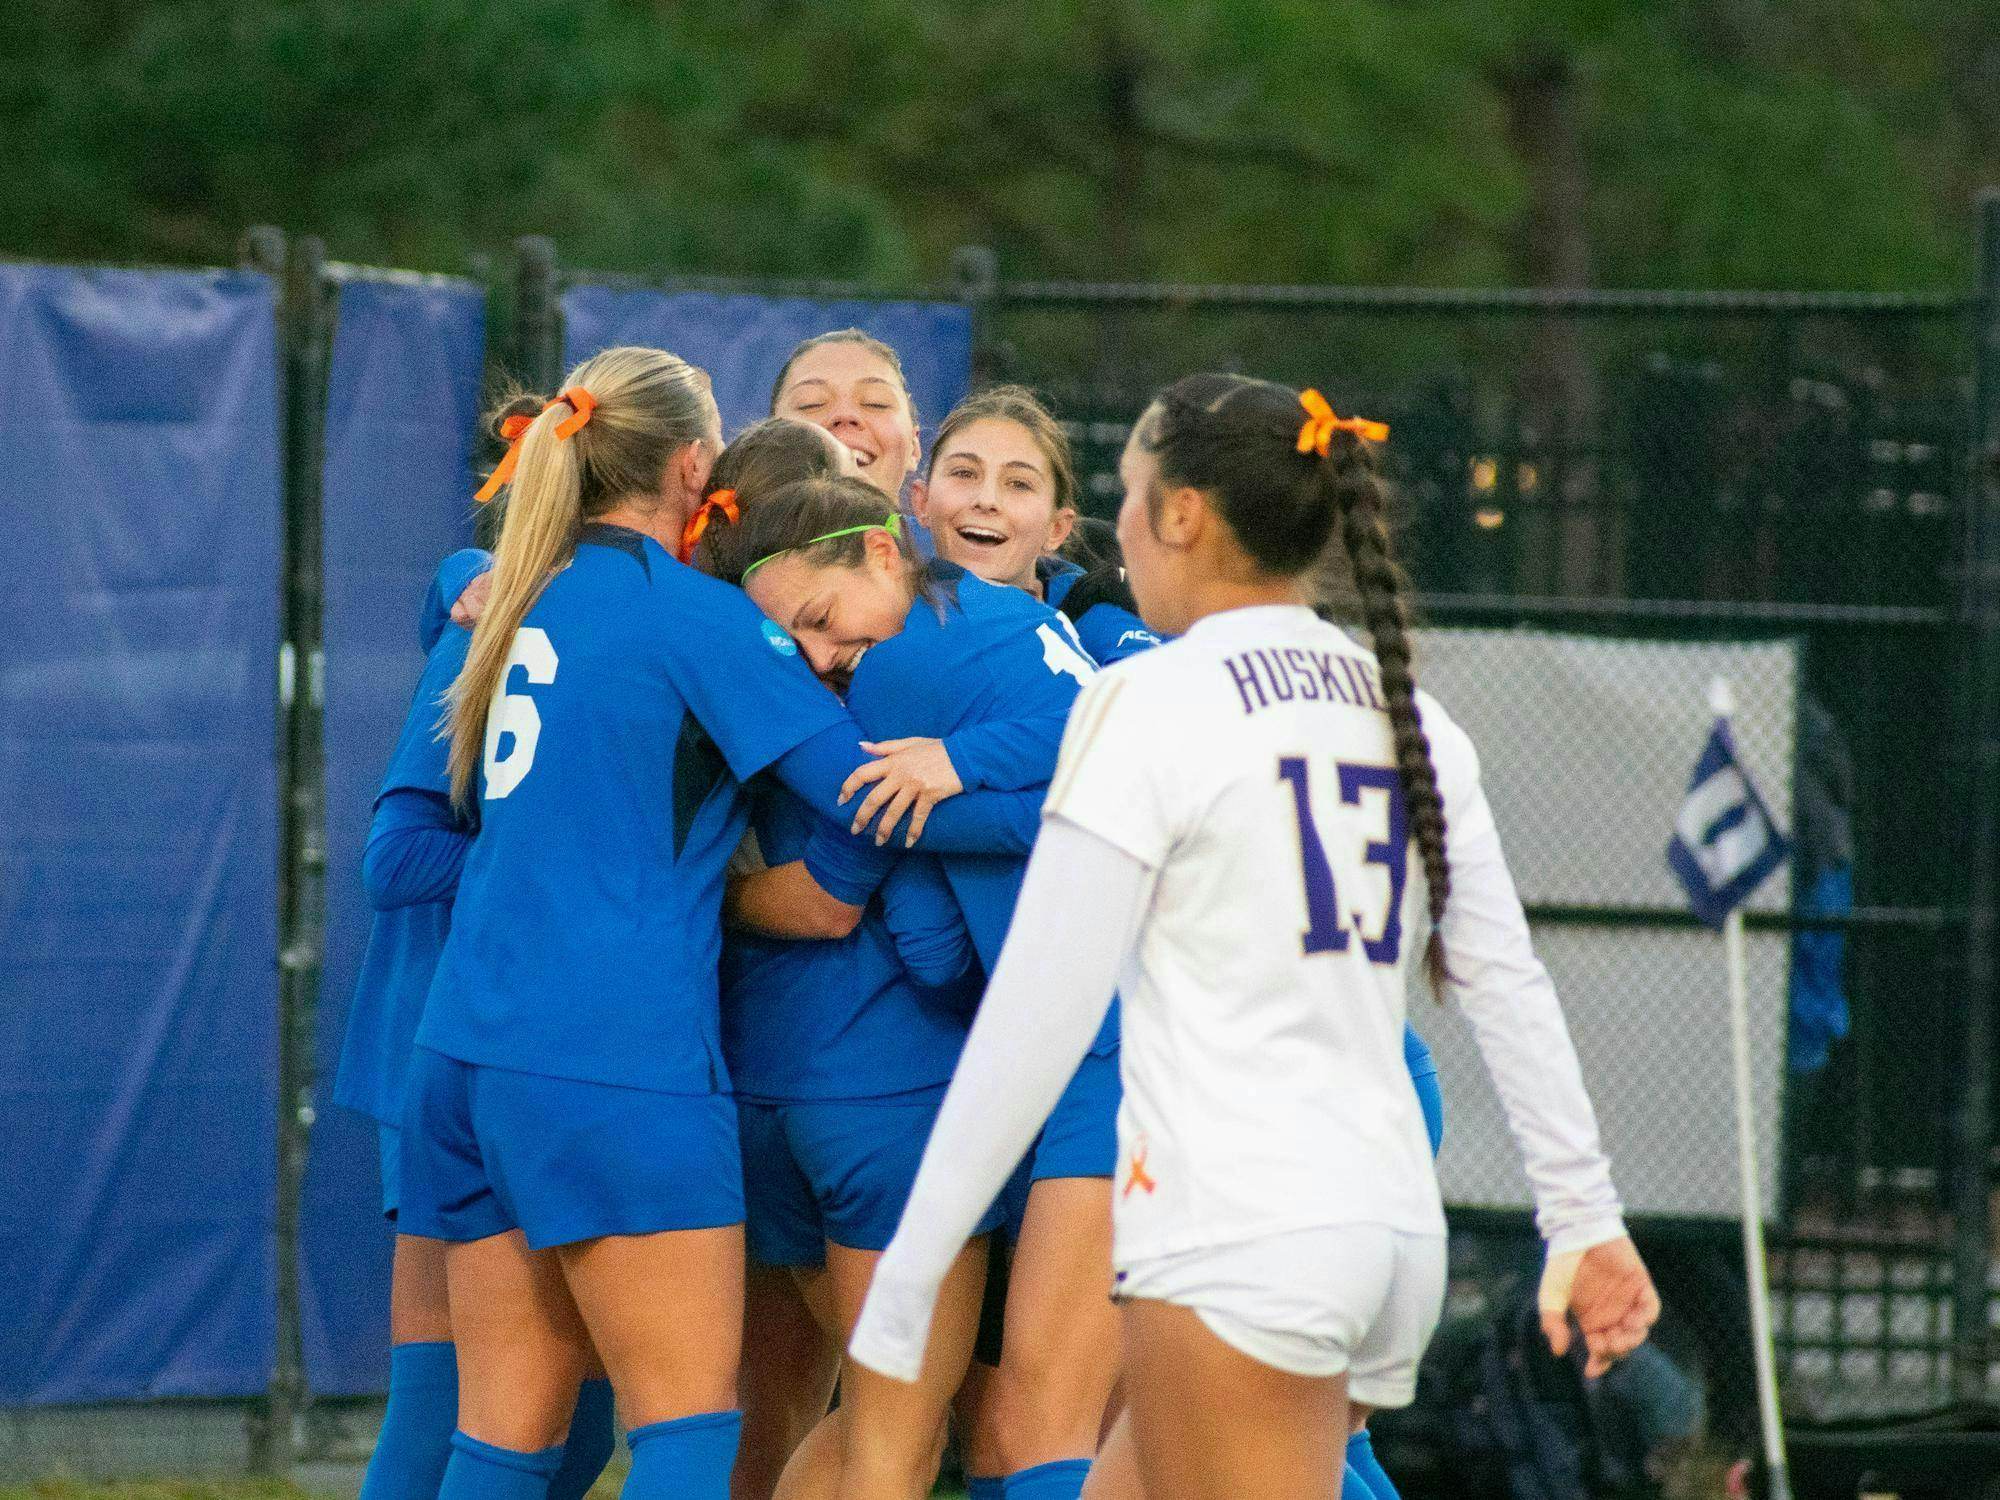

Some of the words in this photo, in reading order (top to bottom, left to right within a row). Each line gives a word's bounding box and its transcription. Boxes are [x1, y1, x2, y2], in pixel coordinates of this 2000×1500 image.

[1036, 609, 1100, 687] 1
[1223, 648, 1391, 715] HUSKIE
[484, 627, 559, 800] 6
[1277, 755, 1411, 966] 13
